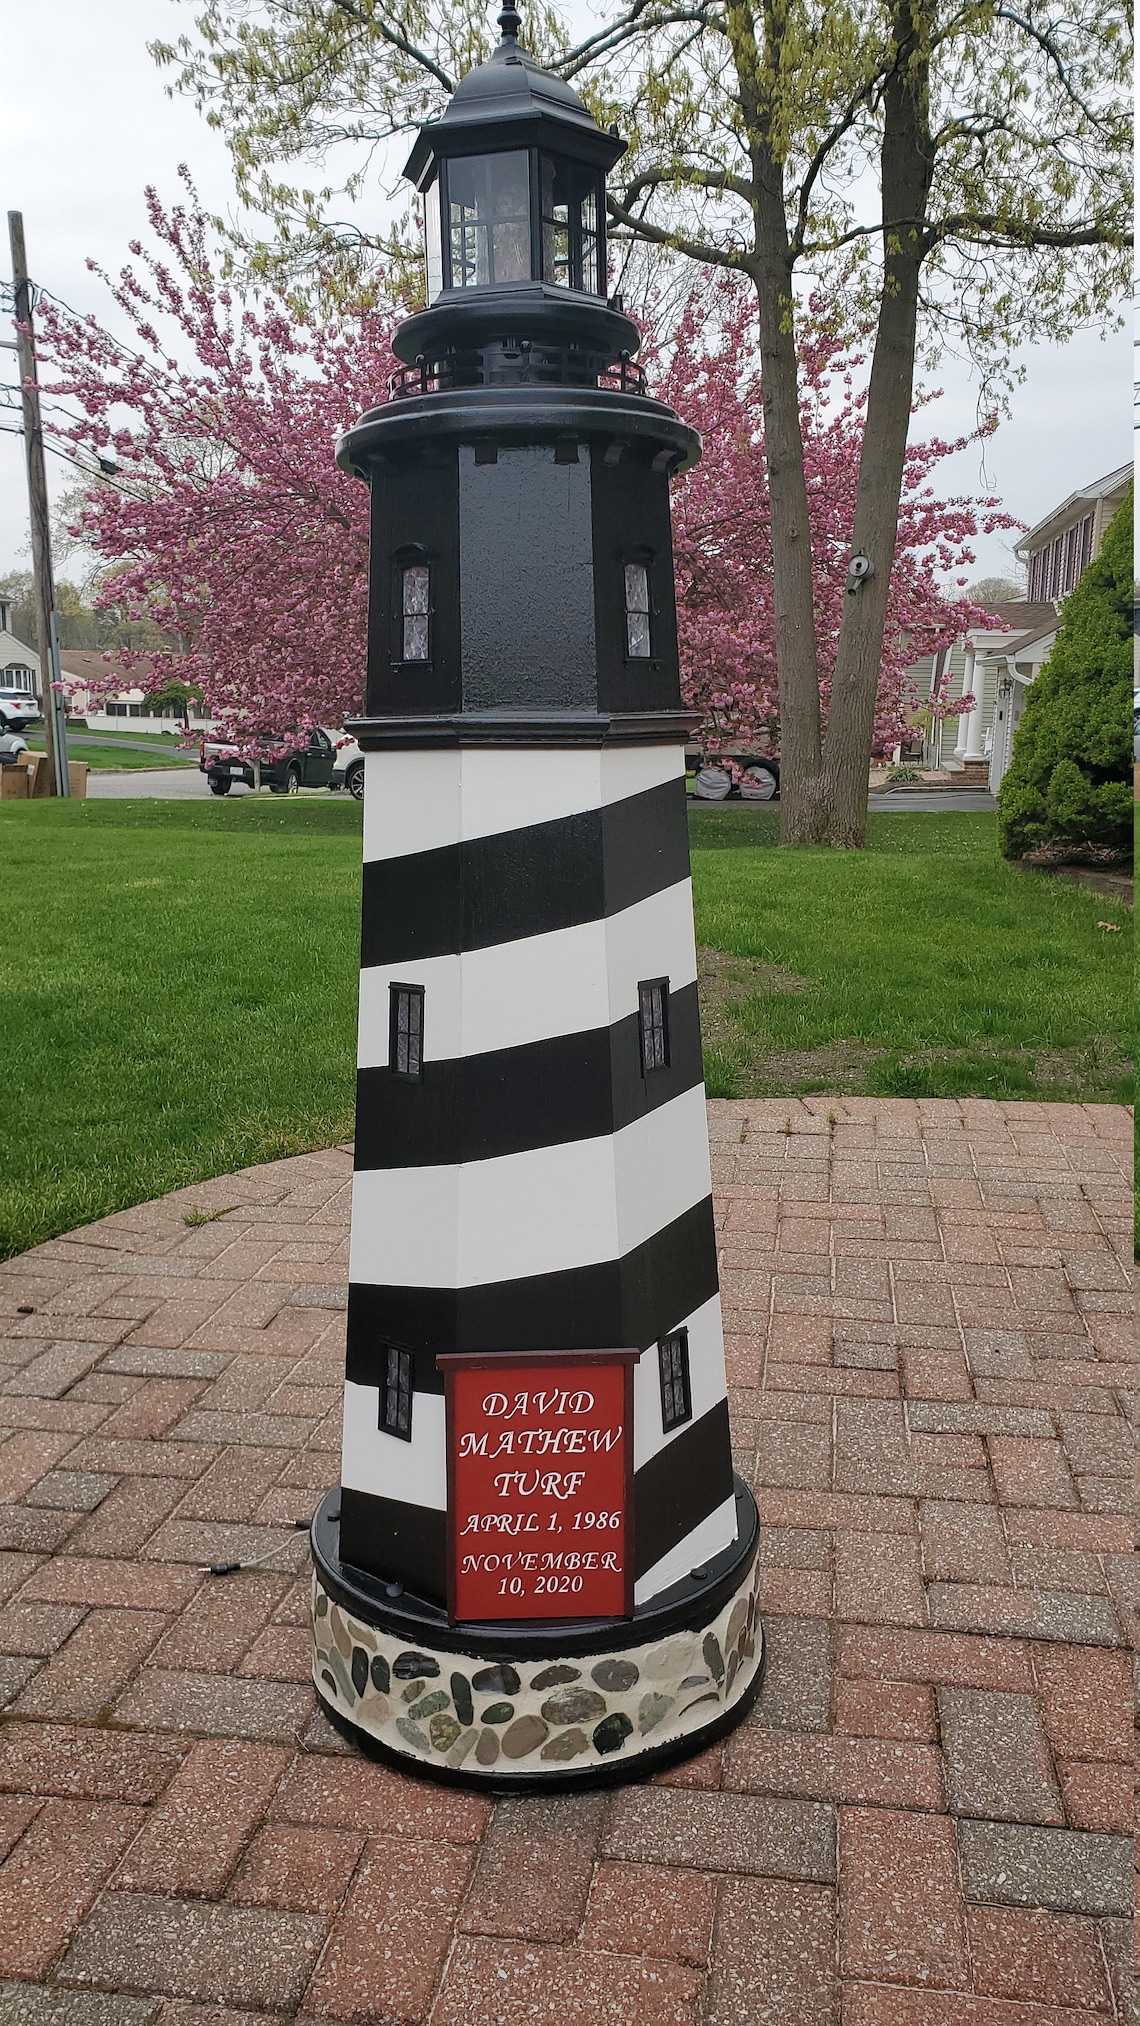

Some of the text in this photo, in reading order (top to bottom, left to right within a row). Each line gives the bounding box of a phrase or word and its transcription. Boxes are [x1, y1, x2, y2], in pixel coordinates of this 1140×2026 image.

[483, 1388, 594, 1419] DAVID
[459, 1426, 622, 1458] MATHEW
[494, 1469, 585, 1499] TURF
[460, 1511, 621, 1535] APRIL 1, 1986
[461, 1551, 622, 1574] NOVEMBER
[498, 1576, 582, 1596] 10, 2020
